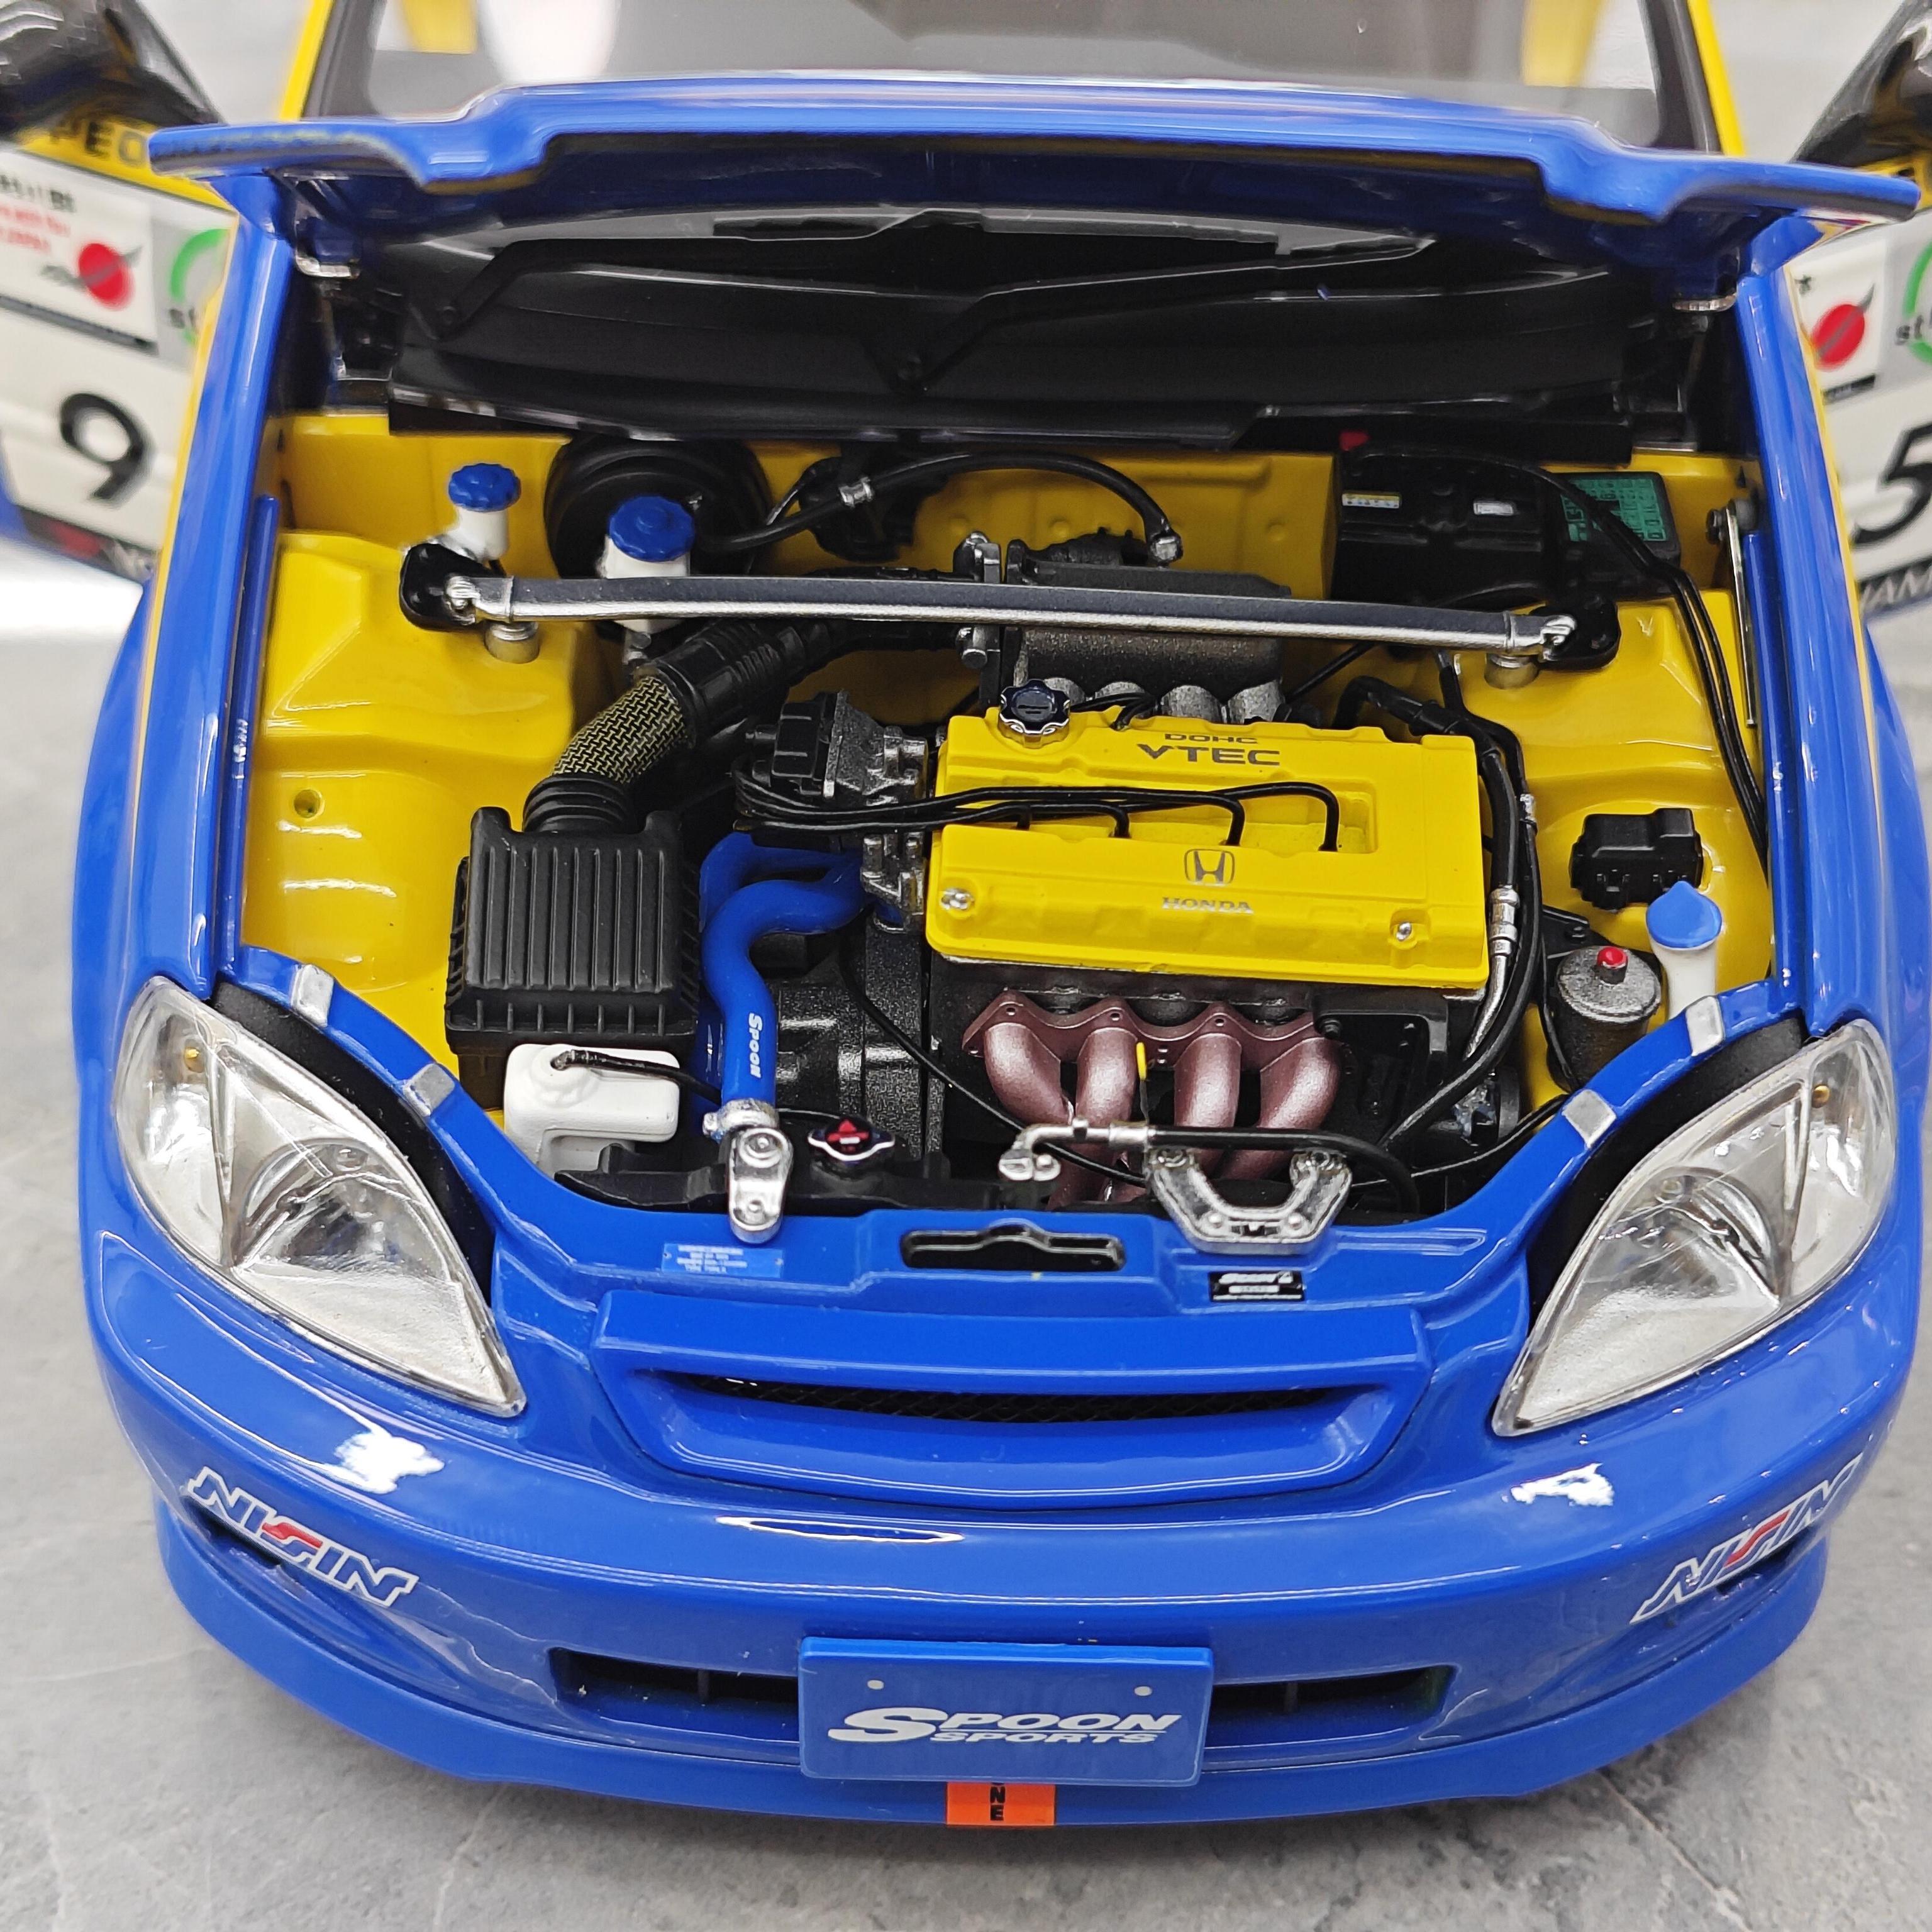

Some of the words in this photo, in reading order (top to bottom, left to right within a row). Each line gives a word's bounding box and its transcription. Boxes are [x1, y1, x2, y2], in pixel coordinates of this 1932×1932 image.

[61, 392, 145, 501] 9
[1852, 420, 1932, 546] 5
[1164, 733, 1258, 744] DOHC
[1136, 743, 1280, 766] VTEC
[1162, 896, 1255, 914] HONDA
[828, 1707, 1182, 1742] SPOON
[930, 1733, 1159, 1744] SPORTS
